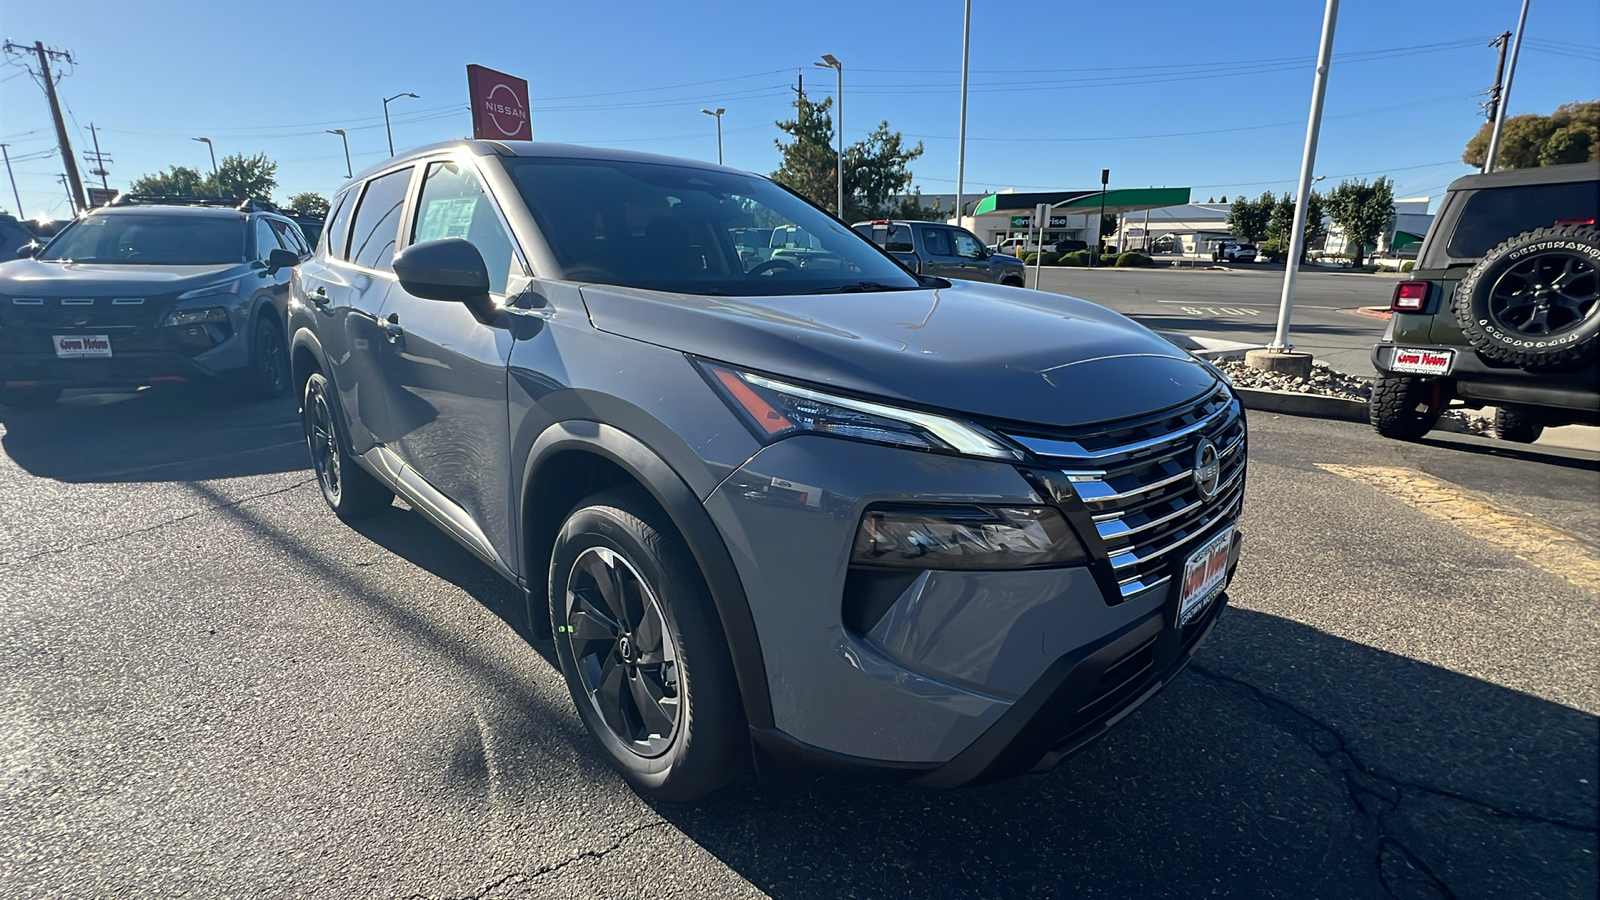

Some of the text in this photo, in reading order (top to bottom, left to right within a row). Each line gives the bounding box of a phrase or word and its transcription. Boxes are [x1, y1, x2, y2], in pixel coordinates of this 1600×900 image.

[485, 101, 526, 119] NISSAN
[1509, 241, 1600, 260] DESTINATIO
[1195, 465, 1218, 481] NISS
